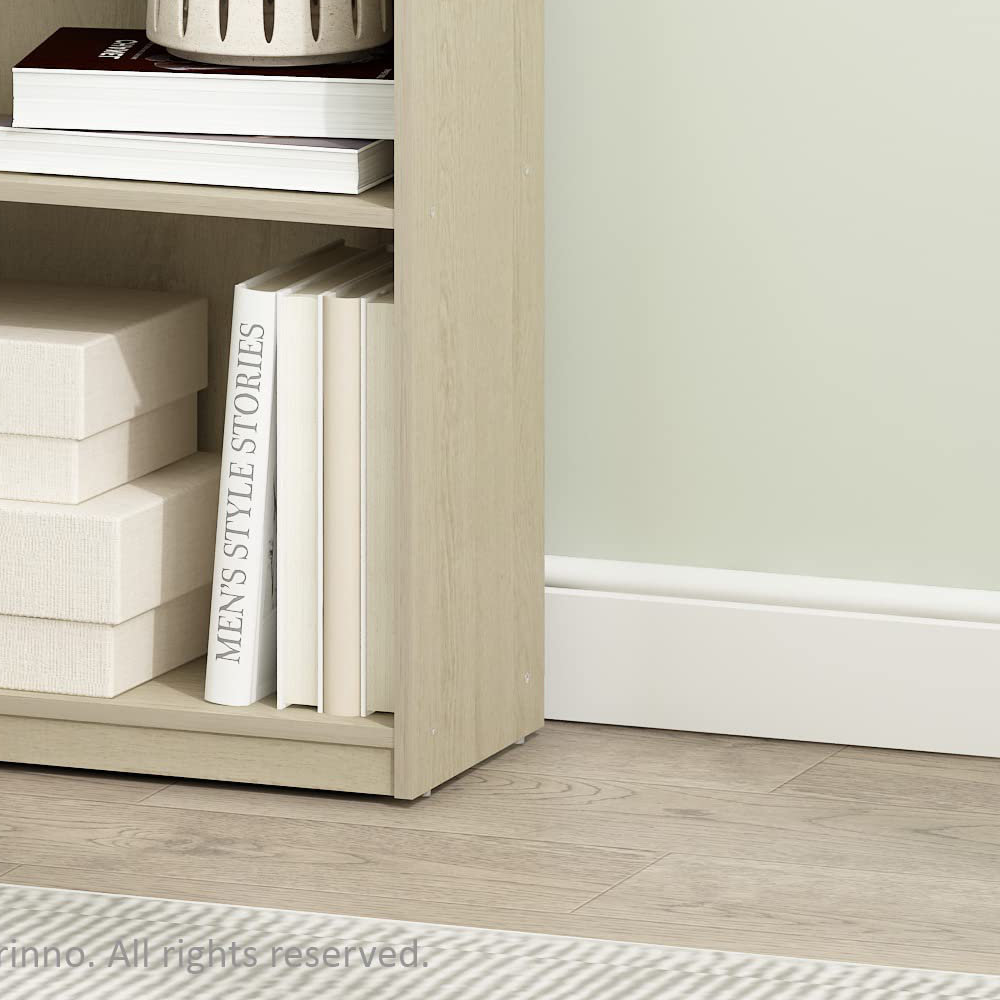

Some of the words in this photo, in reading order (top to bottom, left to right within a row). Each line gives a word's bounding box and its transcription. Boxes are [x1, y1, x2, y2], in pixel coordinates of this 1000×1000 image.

[230, 322, 265, 455] STORIES
[223, 461, 255, 560] STYLE
[215, 567, 247, 665] MEN'S
